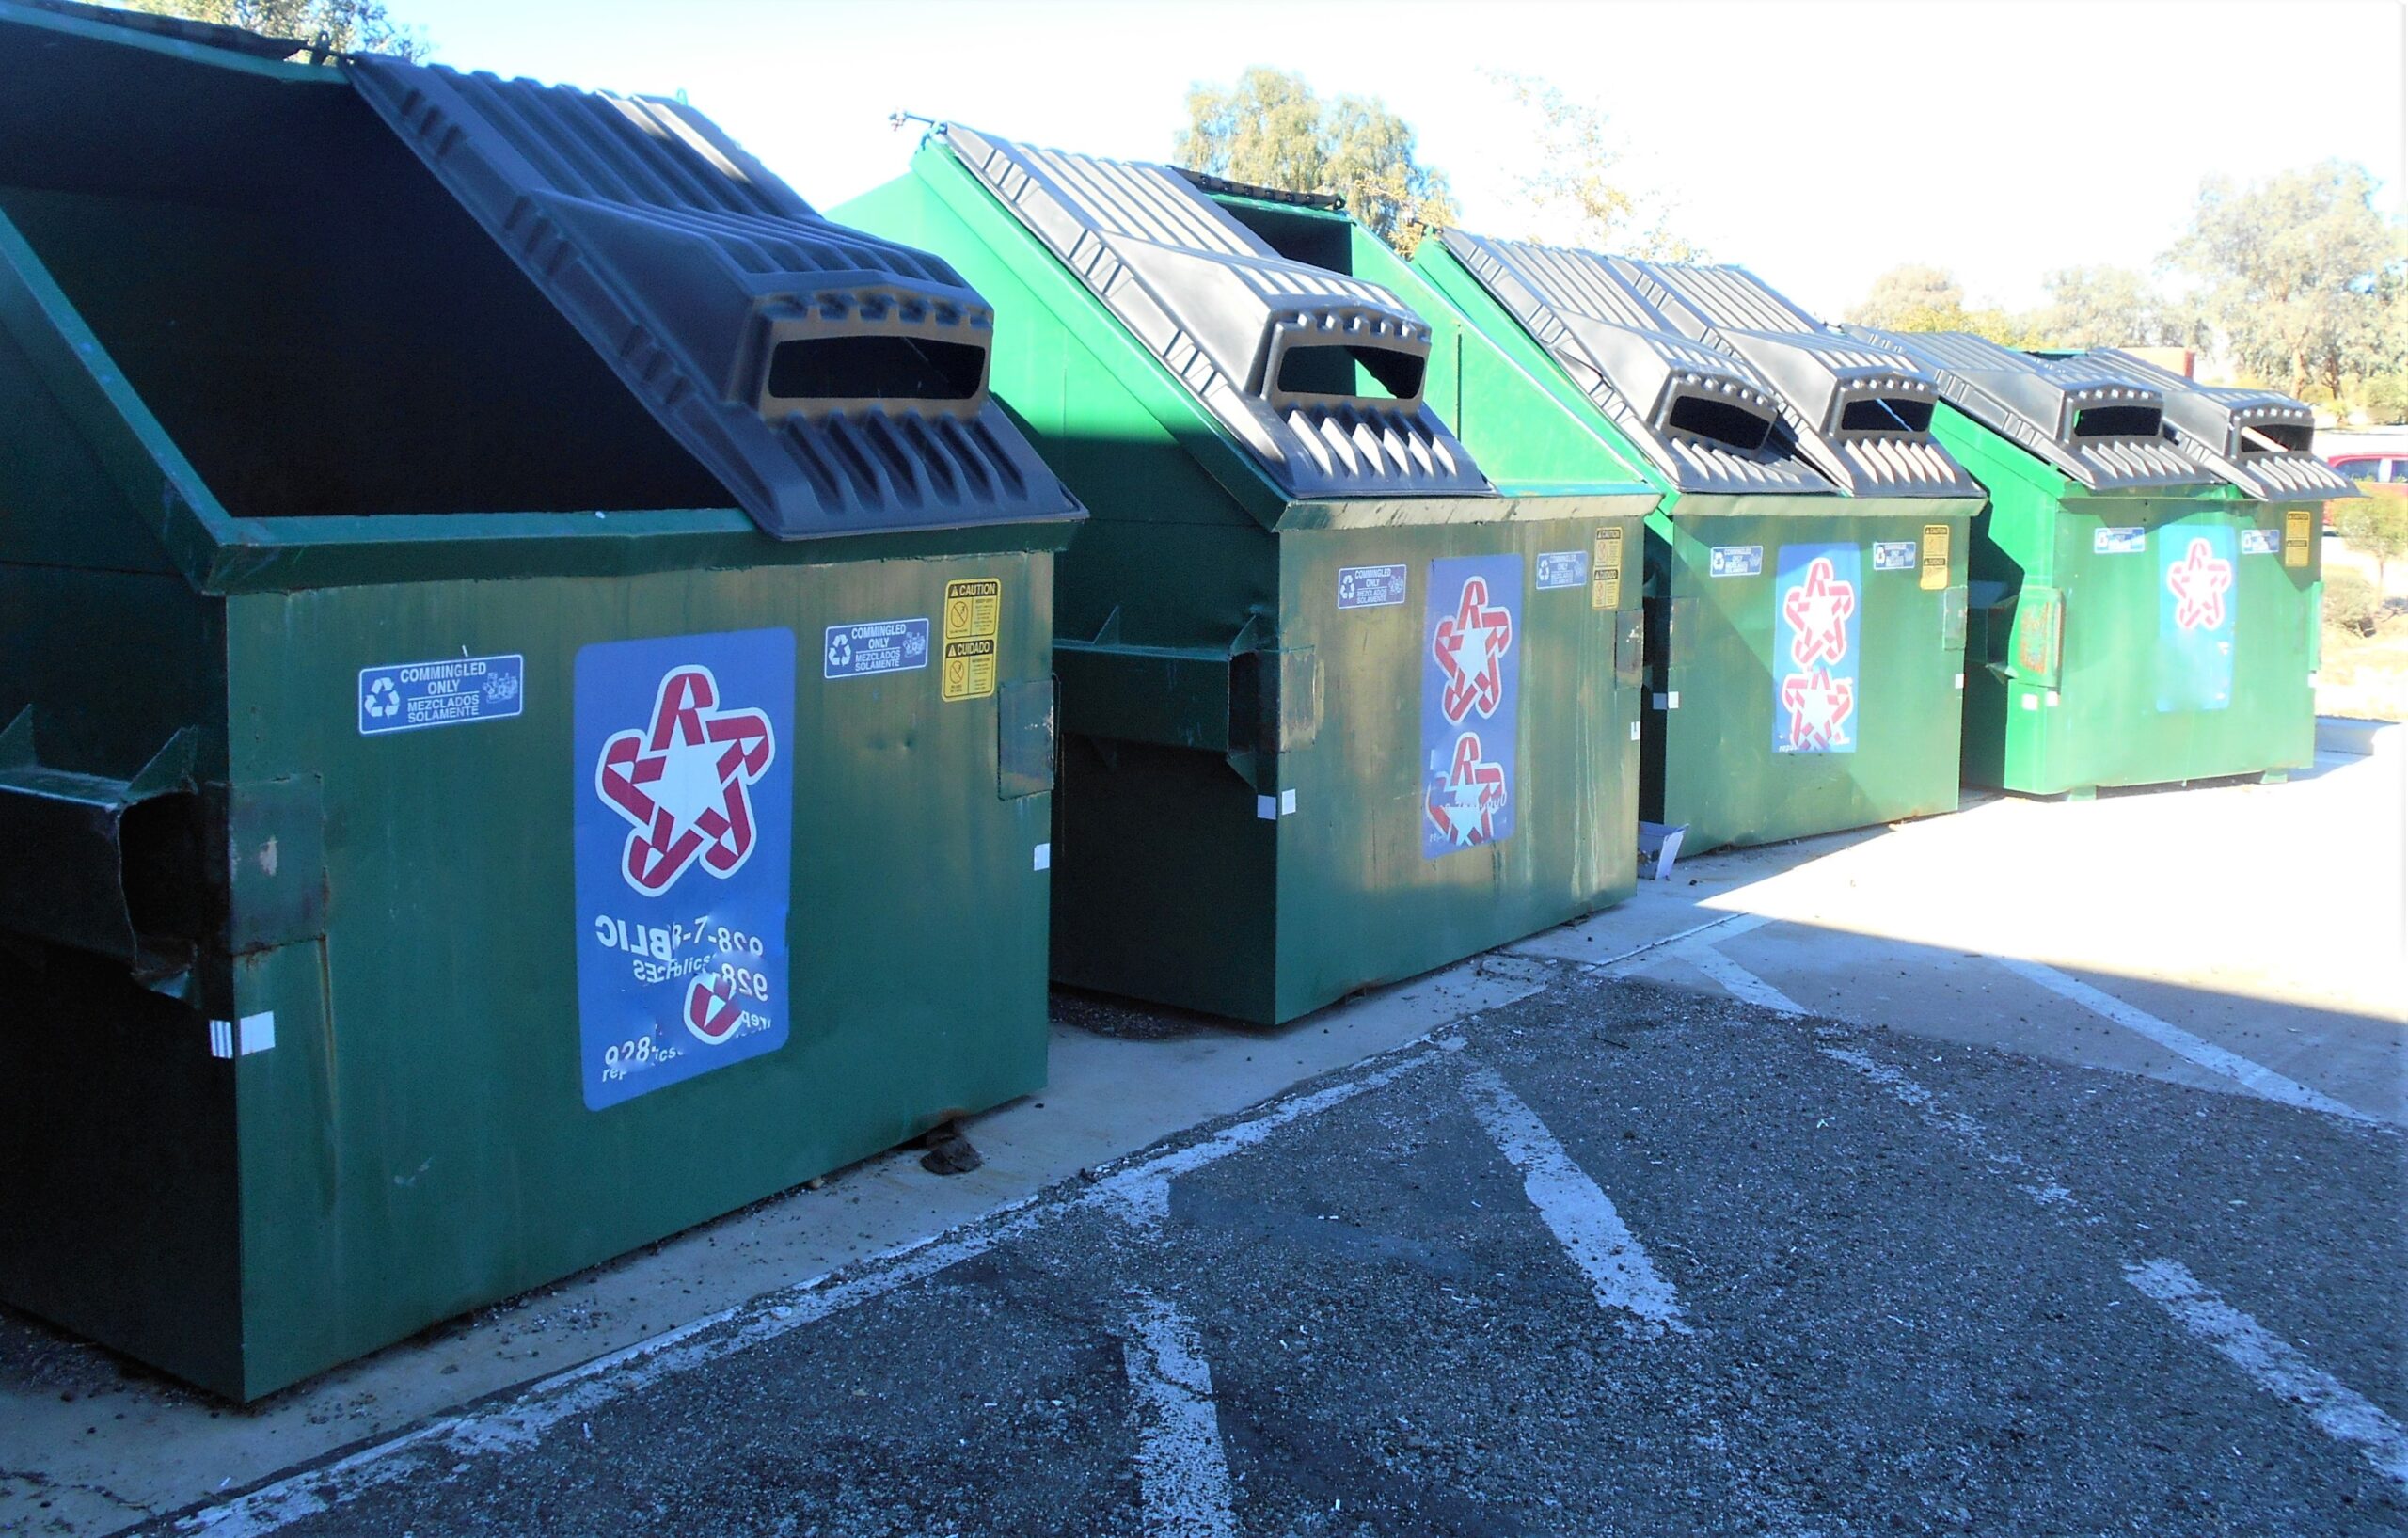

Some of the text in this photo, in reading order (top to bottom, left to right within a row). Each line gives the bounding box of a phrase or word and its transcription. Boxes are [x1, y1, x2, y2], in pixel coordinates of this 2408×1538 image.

[1354, 568, 1391, 579] COMMINGLED
[959, 583, 996, 596] CAUTION
[1366, 578, 1381, 588] ONLY
[851, 624, 907, 640] COMMINGLED
[868, 637, 890, 650] ONLY
[957, 641, 990, 656] CUIDADO
[855, 649, 901, 663] MEZCLADOS
[855, 658, 900, 672] SOLAMENTE
[400, 662, 486, 683] COMMINGLED
[427, 679, 461, 695] ONLY
[407, 693, 480, 712] MEZCLADOS
[407, 706, 479, 723] SOLAMENTE
